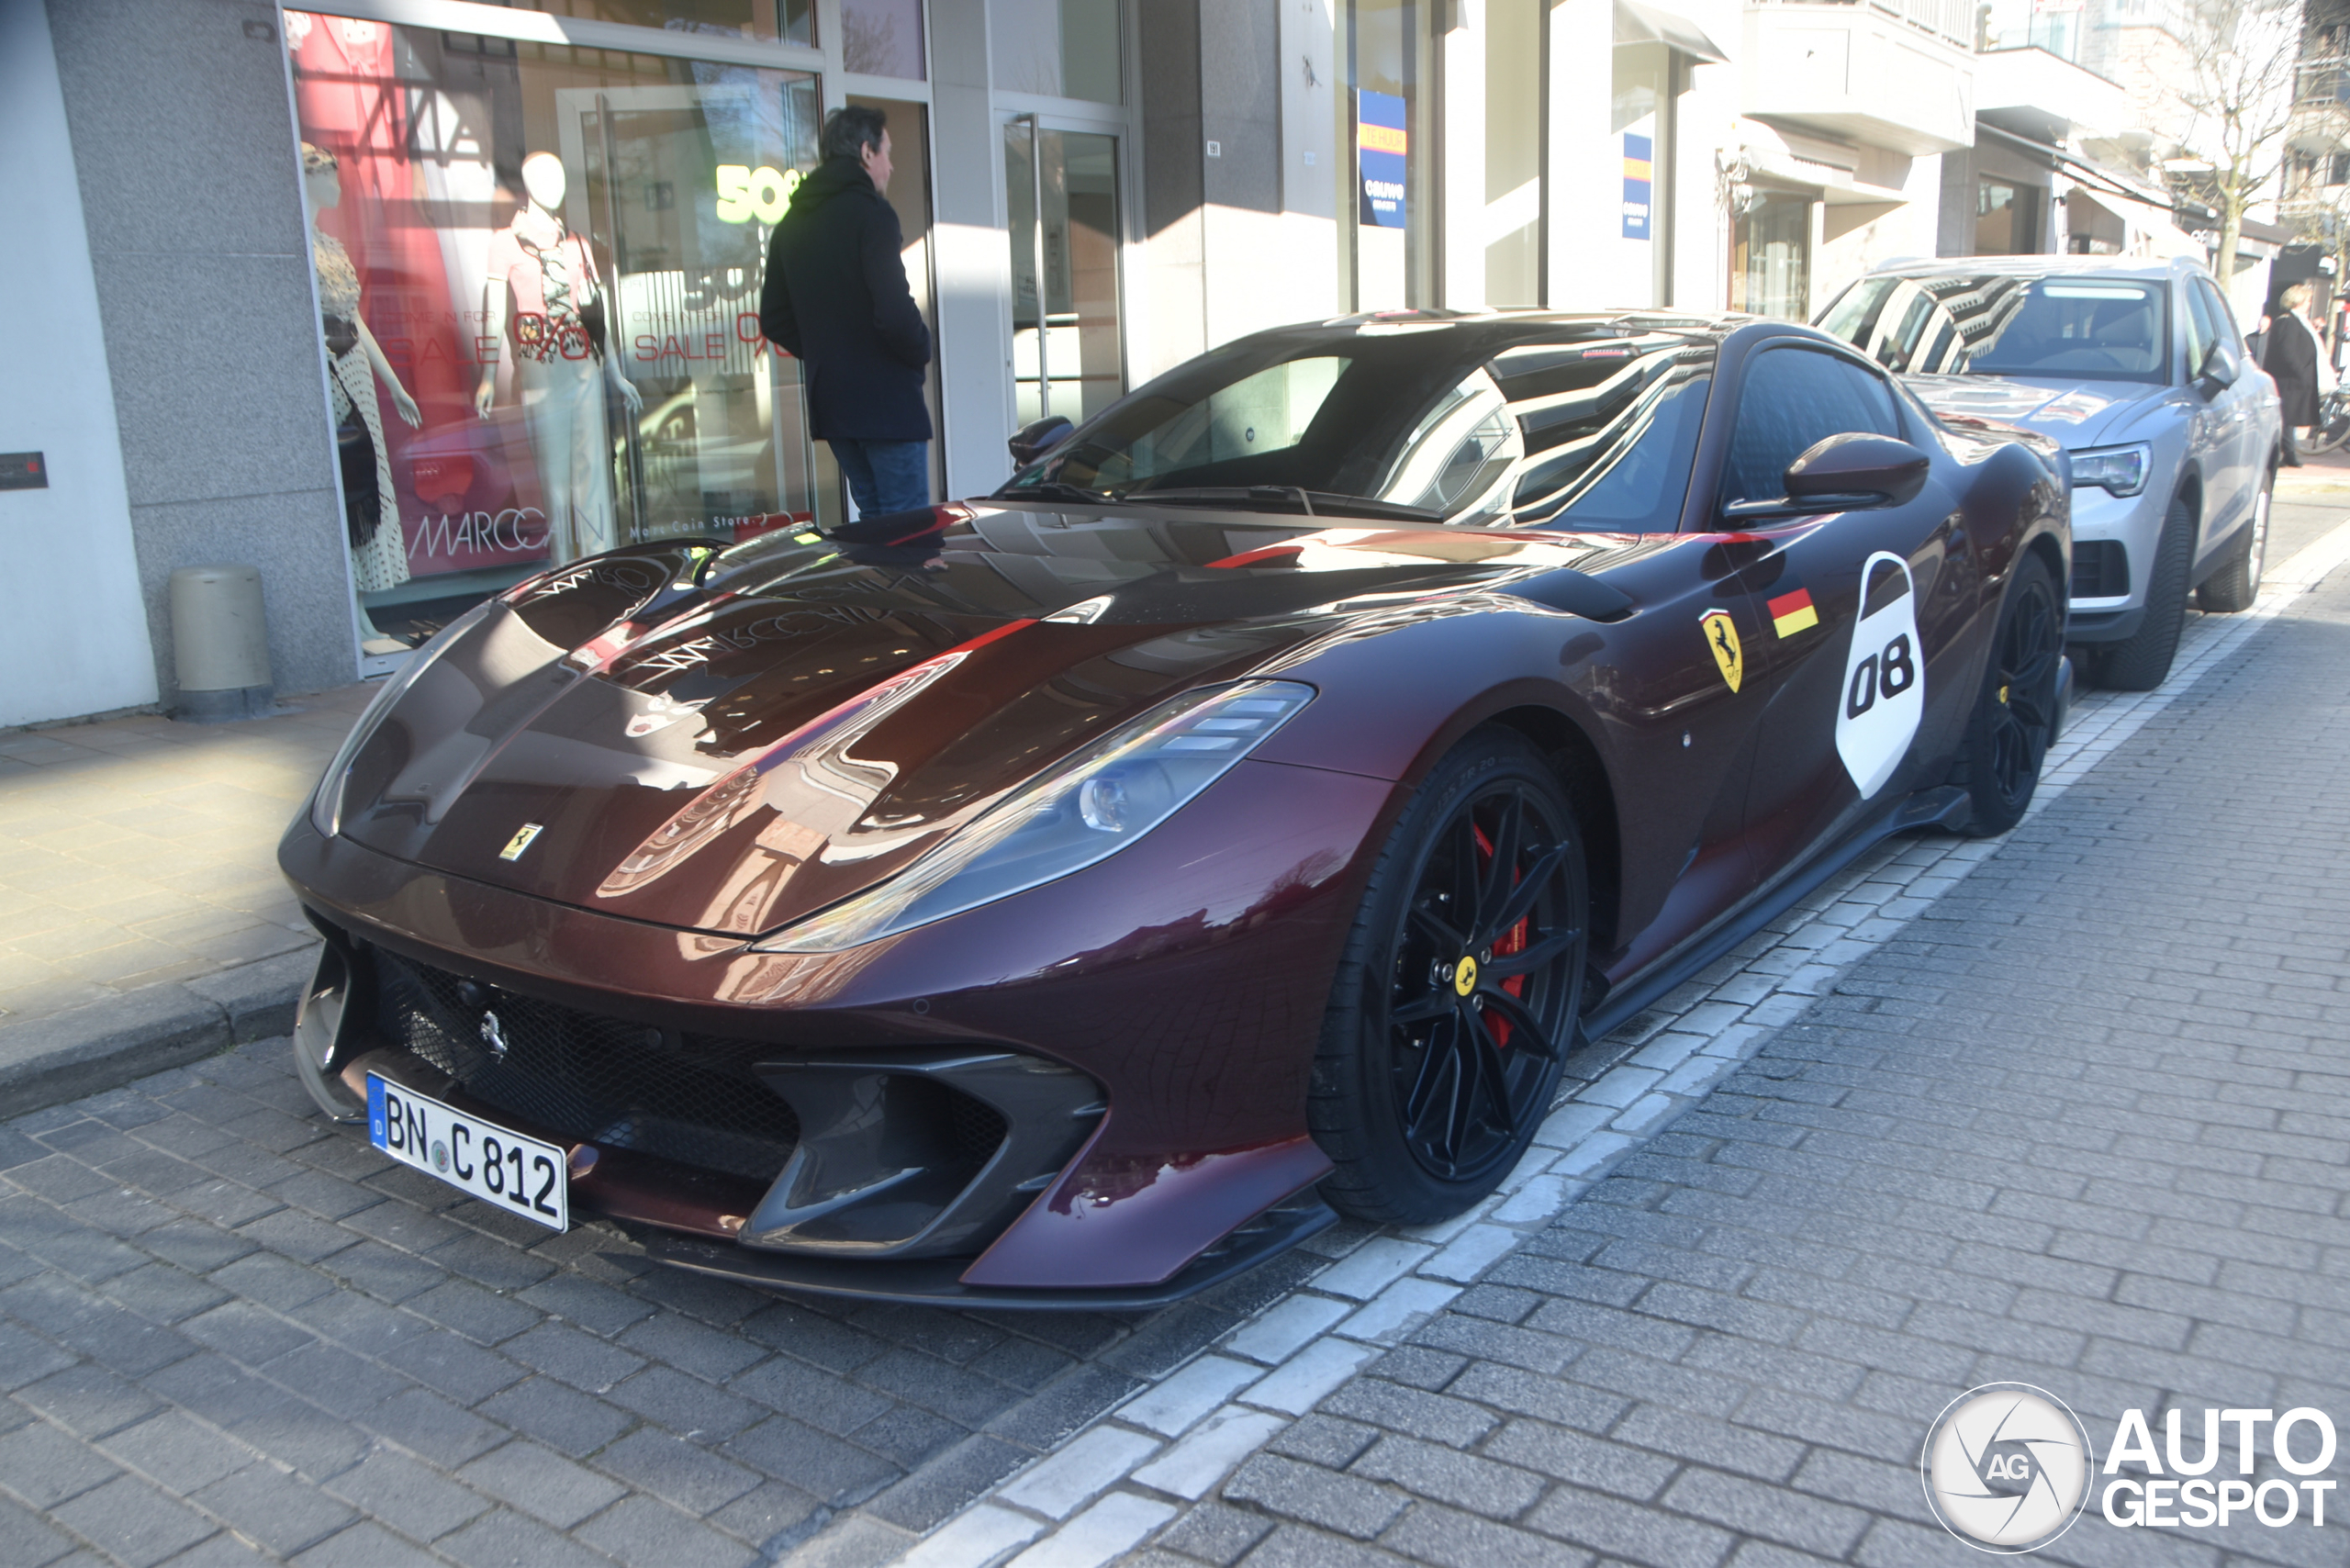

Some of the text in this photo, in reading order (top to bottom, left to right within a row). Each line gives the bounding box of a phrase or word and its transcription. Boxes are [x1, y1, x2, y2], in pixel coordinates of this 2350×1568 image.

[386, 336, 500, 366] SALE
[635, 334, 726, 361] SALE
[630, 526, 666, 538] Marc
[672, 520, 705, 533] Cain
[1847, 633, 1915, 720] 08
[1480, 756, 1495, 771] 20
[375, 1119, 383, 1136] D
[386, 1092, 557, 1218] BN C 812
